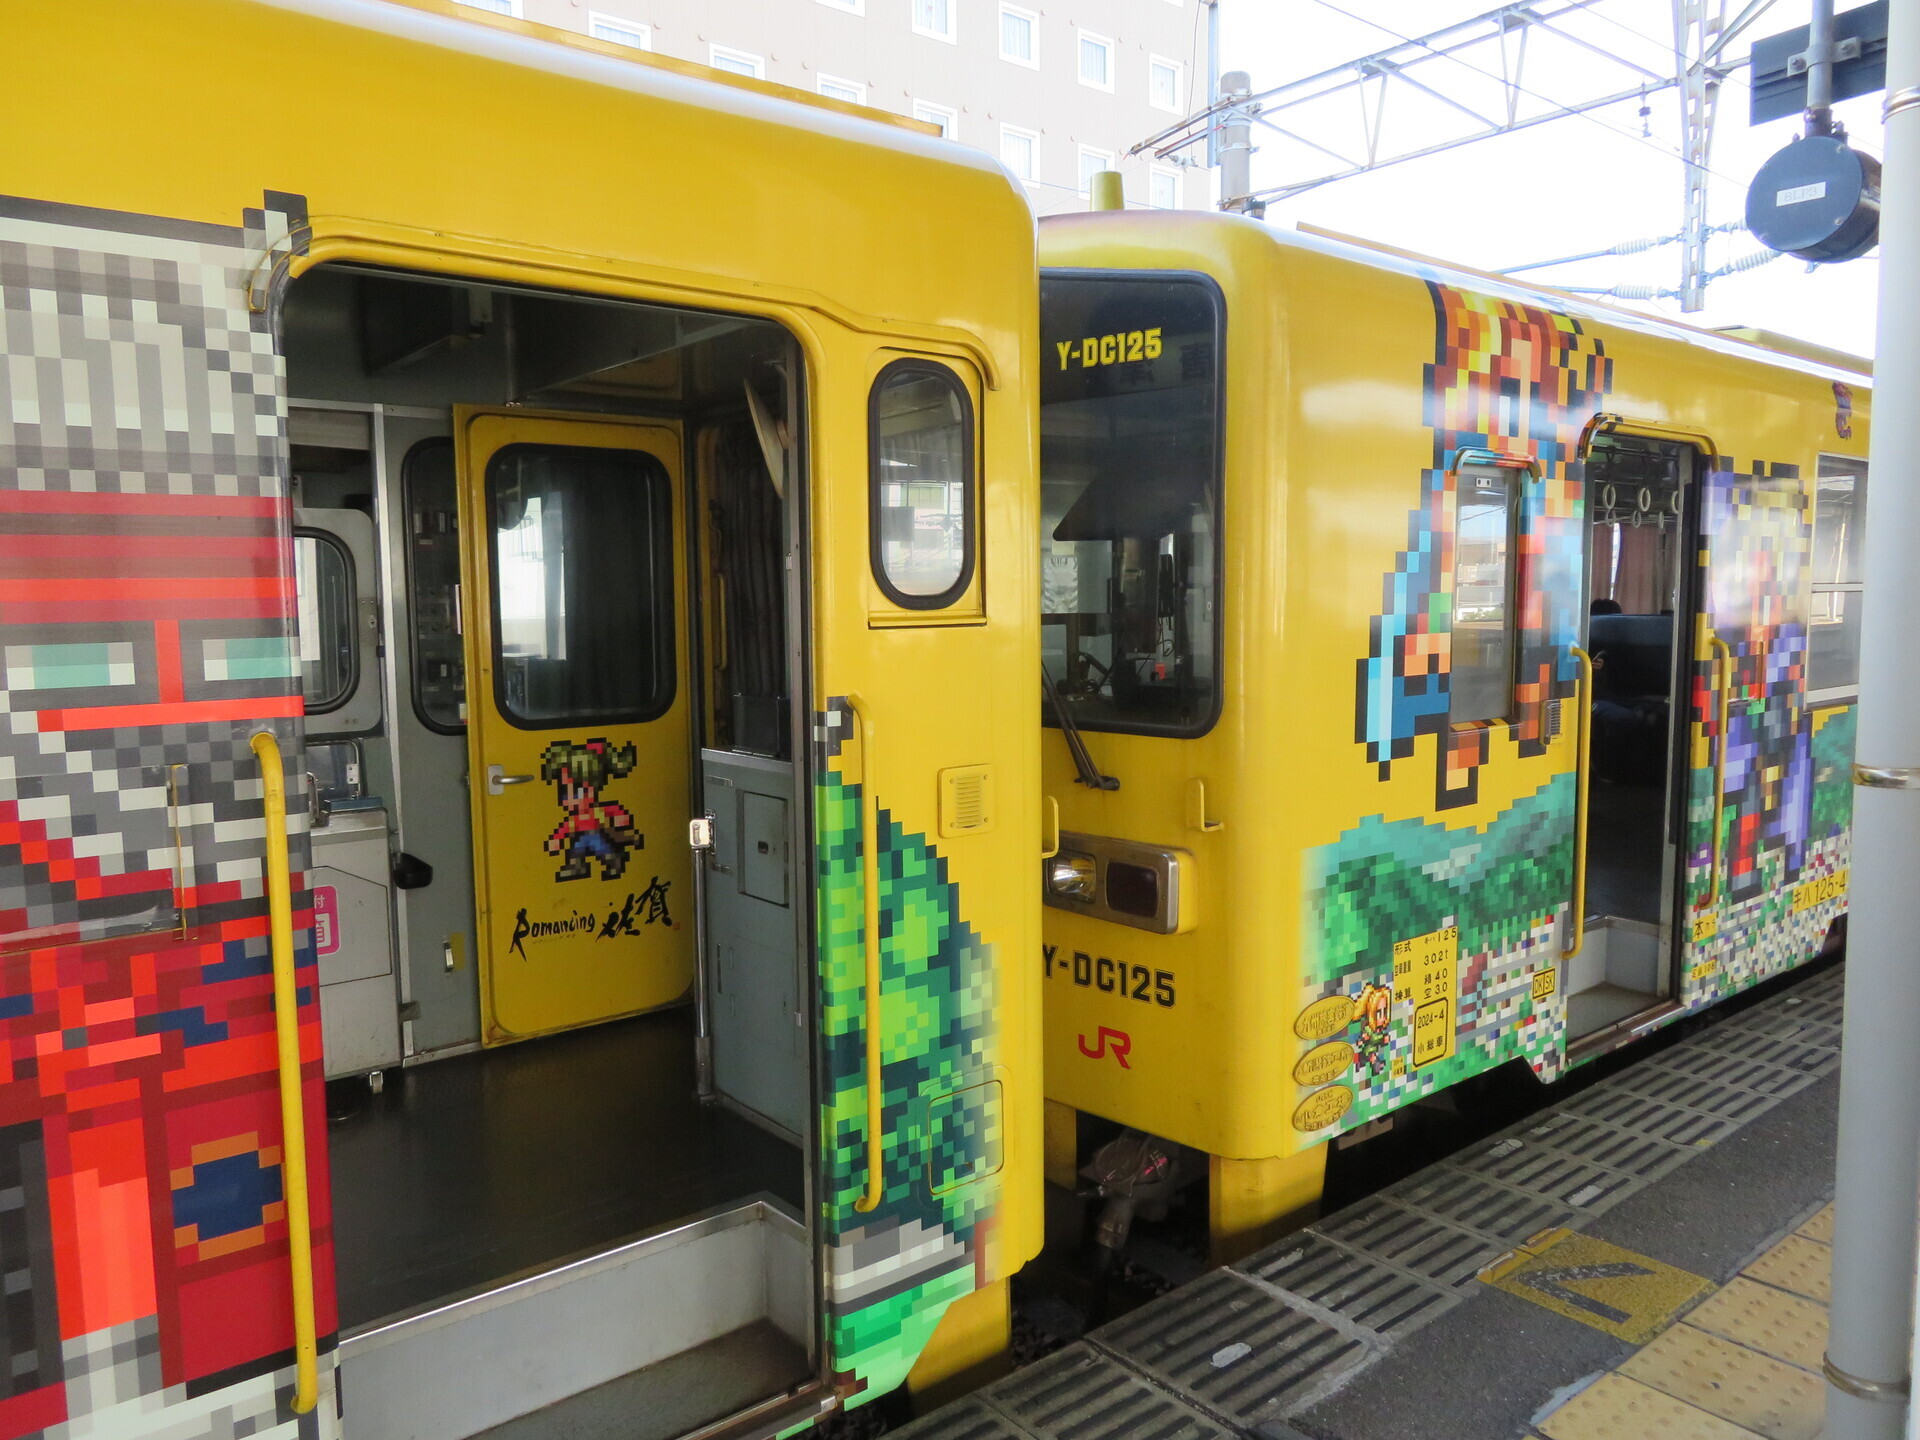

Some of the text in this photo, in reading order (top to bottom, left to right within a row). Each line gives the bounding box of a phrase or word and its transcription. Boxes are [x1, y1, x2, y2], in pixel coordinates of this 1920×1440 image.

[1056, 327, 1163, 371] Y-DC125
[509, 907, 595, 962] Romancing
[1042, 942, 1176, 1009] Y-DC125
[1417, 1008, 1445, 1029] 2024-4
[1078, 1025, 1131, 1070] JR
